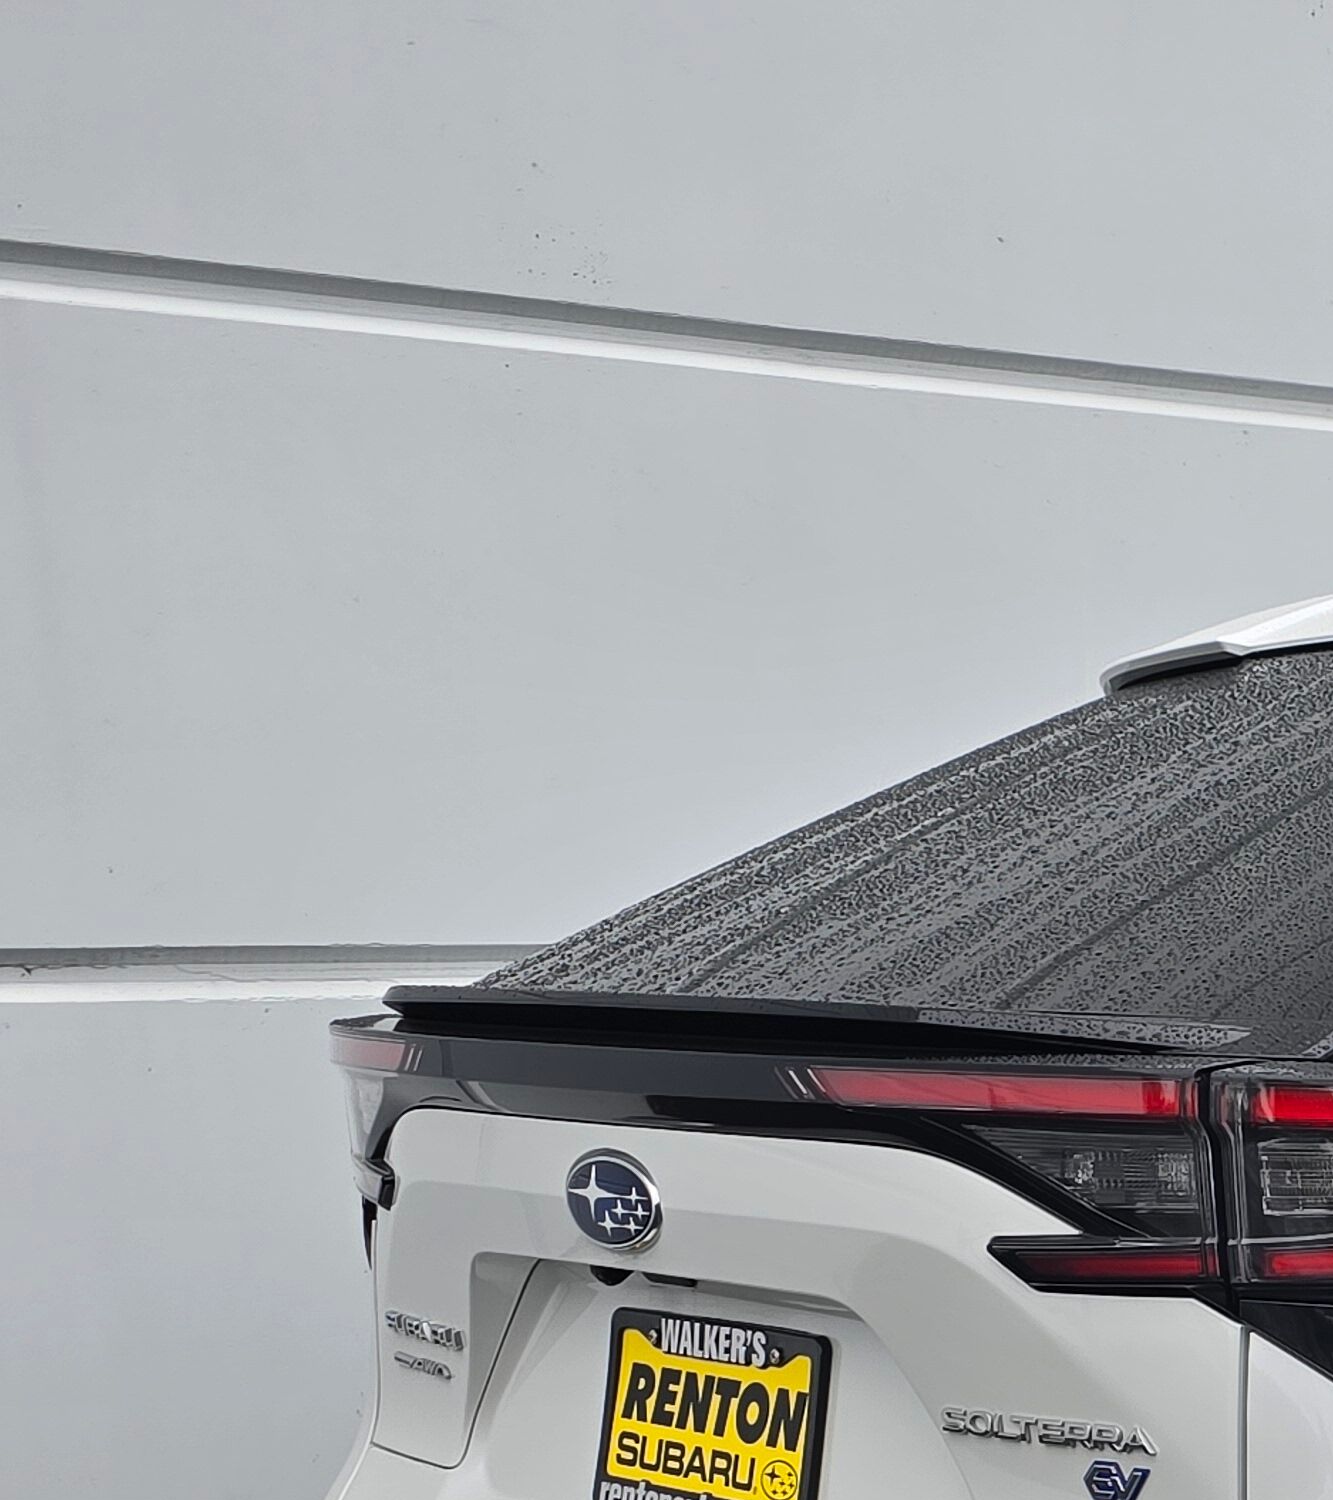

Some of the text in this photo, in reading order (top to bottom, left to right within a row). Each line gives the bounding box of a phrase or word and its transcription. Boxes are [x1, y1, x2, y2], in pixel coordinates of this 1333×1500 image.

[384, 1309, 466, 1353] SUBARU
[660, 1317, 767, 1368] WALKER'S
[620, 1361, 810, 1453] RENTON
[941, 1406, 1160, 1457] SOLTERRA
[615, 1430, 757, 1492] SUBARU
